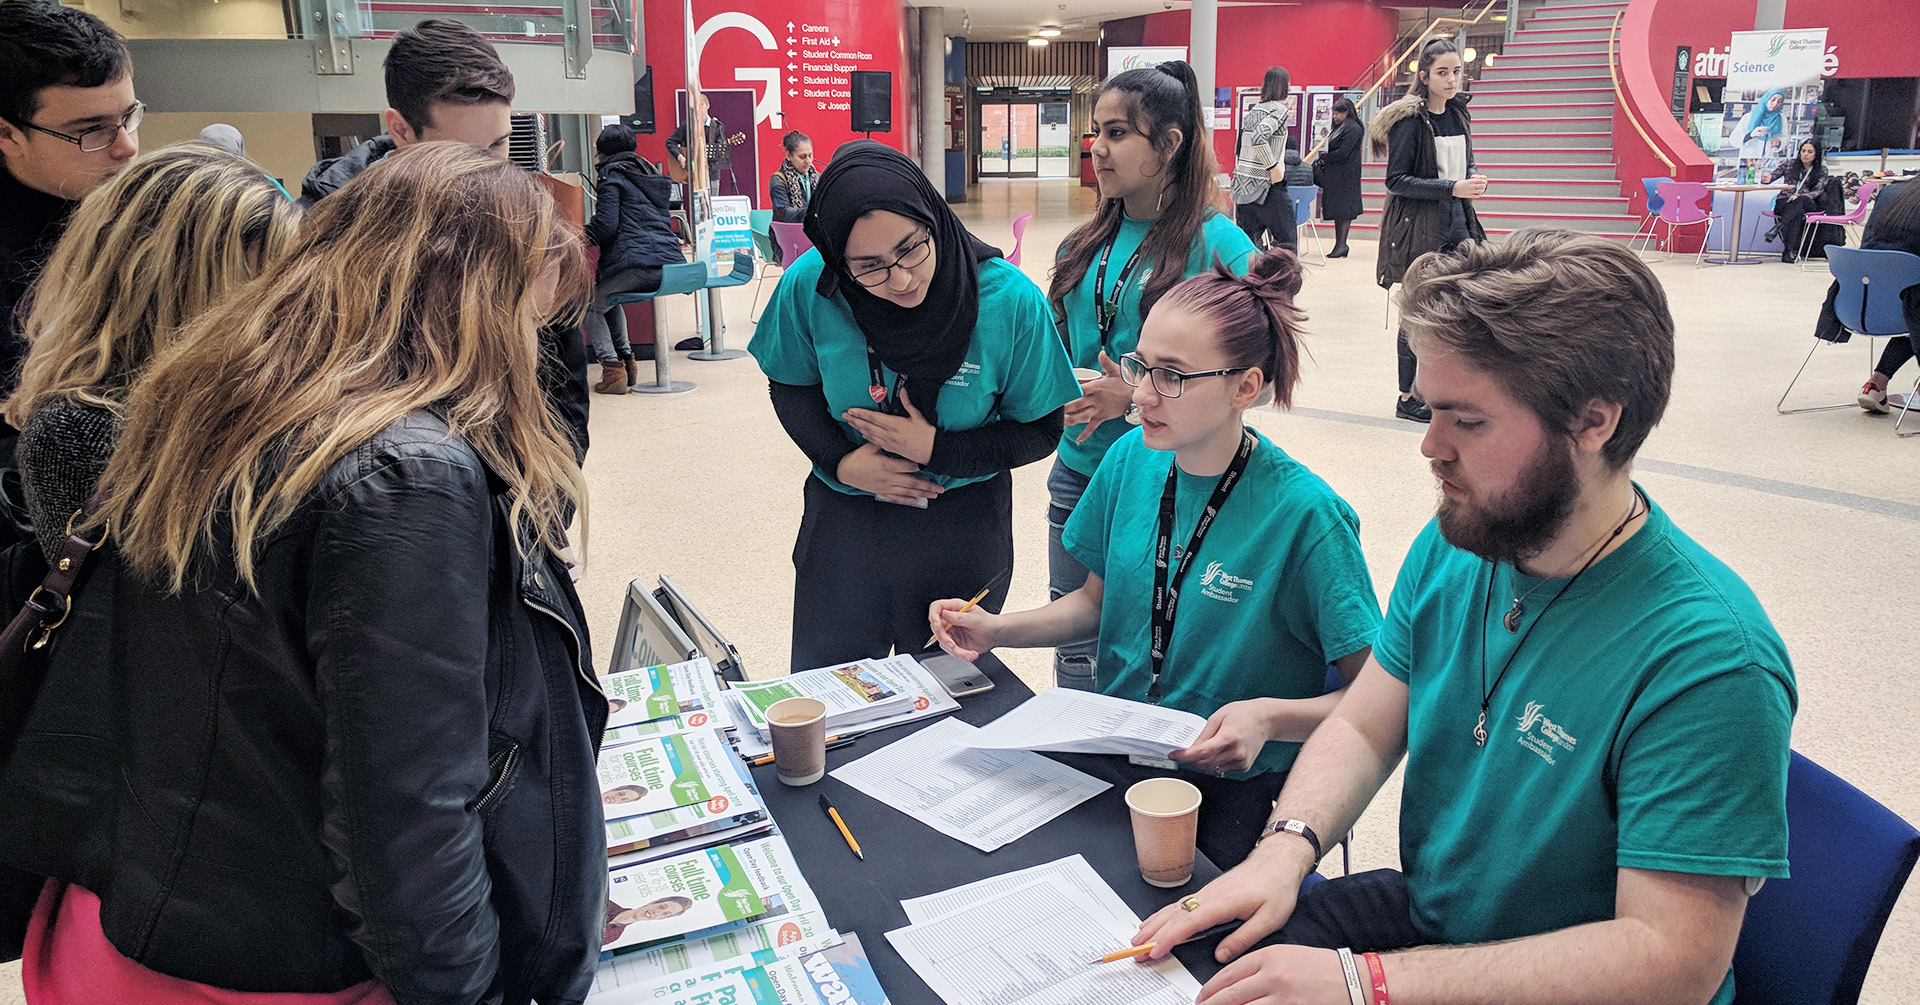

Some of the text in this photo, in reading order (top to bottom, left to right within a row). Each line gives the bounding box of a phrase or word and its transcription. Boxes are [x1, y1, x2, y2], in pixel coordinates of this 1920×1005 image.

[802, 24, 829, 33] Careers
[802, 37, 831, 46] First Aid
[803, 50, 873, 60] Student Common Room
[1695, 47, 1729, 76] atri
[803, 63, 858, 73] Financial Support
[1733, 62, 1775, 73] Science
[804, 76, 848, 85] Student Union
[804, 89, 830, 98] Student
[817, 102, 827, 110] Sir
[1221, 471, 1237, 493] Student
[1200, 587, 1239, 604] Ambassador
[1208, 584, 1233, 597] Student
[623, 673, 645, 703] Full time
[1517, 736, 1556, 765] Ambassador
[1527, 732, 1553, 753] Student
[623, 752, 642, 782] courses
[636, 748, 665, 791] Full time
[703, 748, 717, 769] courses
[715, 768, 727, 787] starting
[663, 864, 686, 893] courses
[743, 847, 771, 891] Open Day feedback
[760, 841, 802, 912] Welcome to our Open Day
[677, 859, 711, 901] Full time
[769, 970, 782, 989] Open
